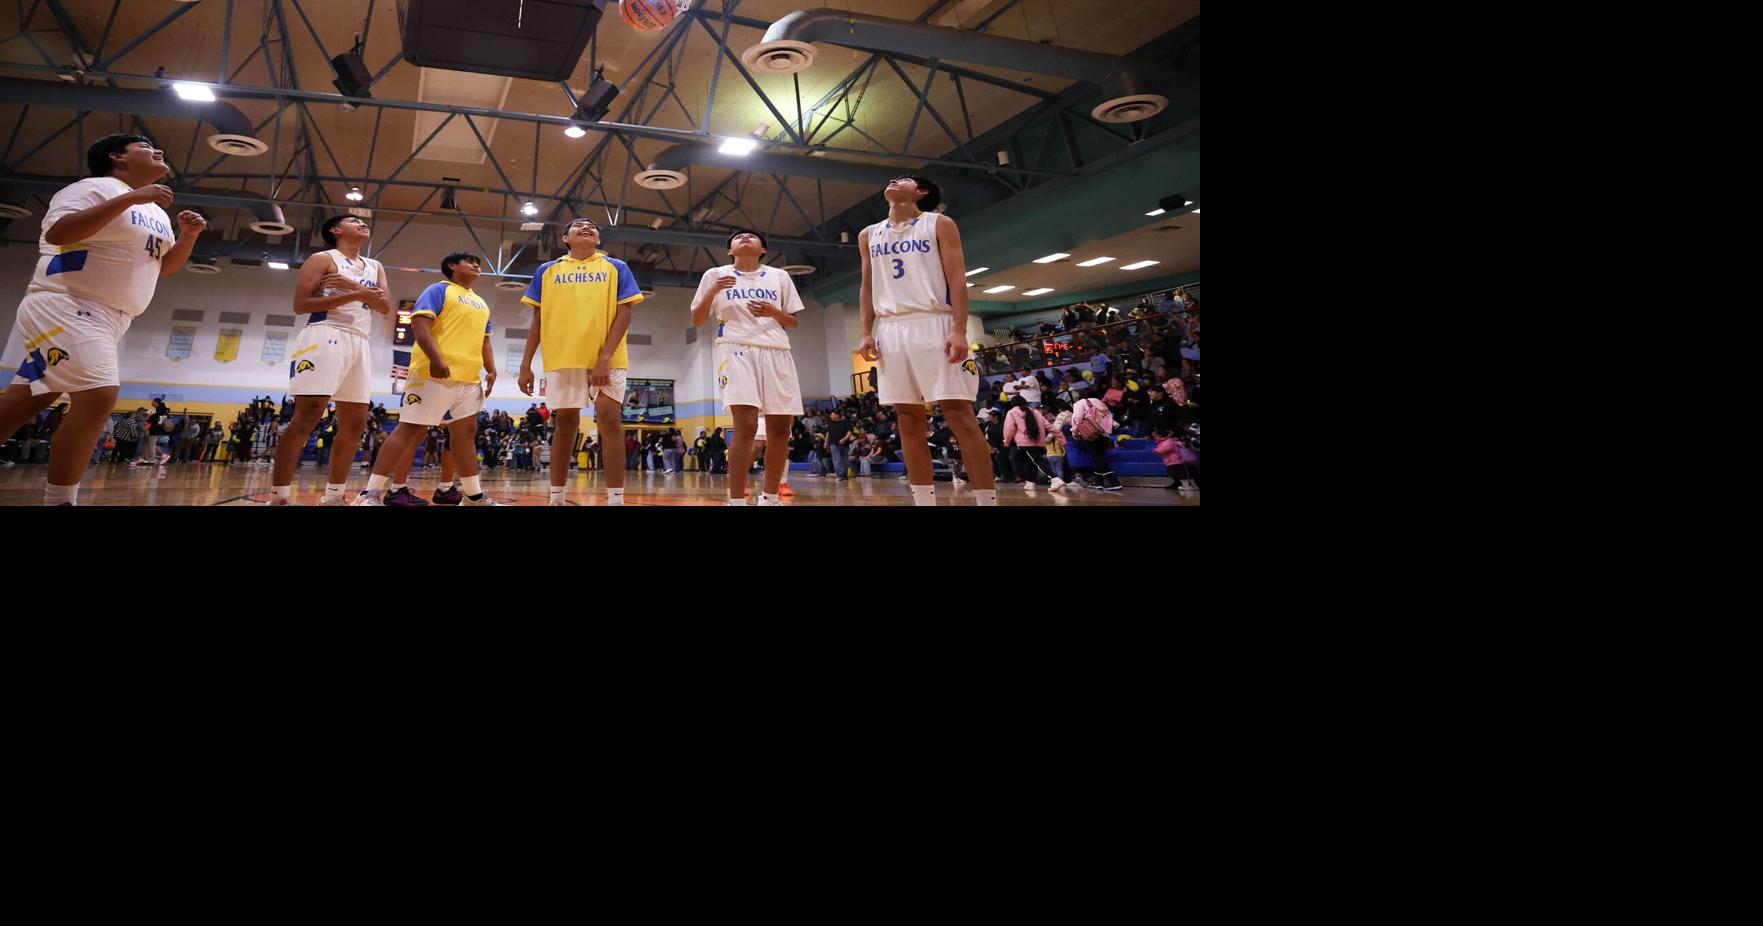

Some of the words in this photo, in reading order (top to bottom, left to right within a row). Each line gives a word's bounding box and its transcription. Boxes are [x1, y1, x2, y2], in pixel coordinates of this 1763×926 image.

[145, 233, 163, 261] 45
[871, 239, 931, 258] FALCONS
[892, 258, 905, 279] 3
[554, 272, 608, 285] ALCHESAY
[726, 288, 778, 301] FALCONS
